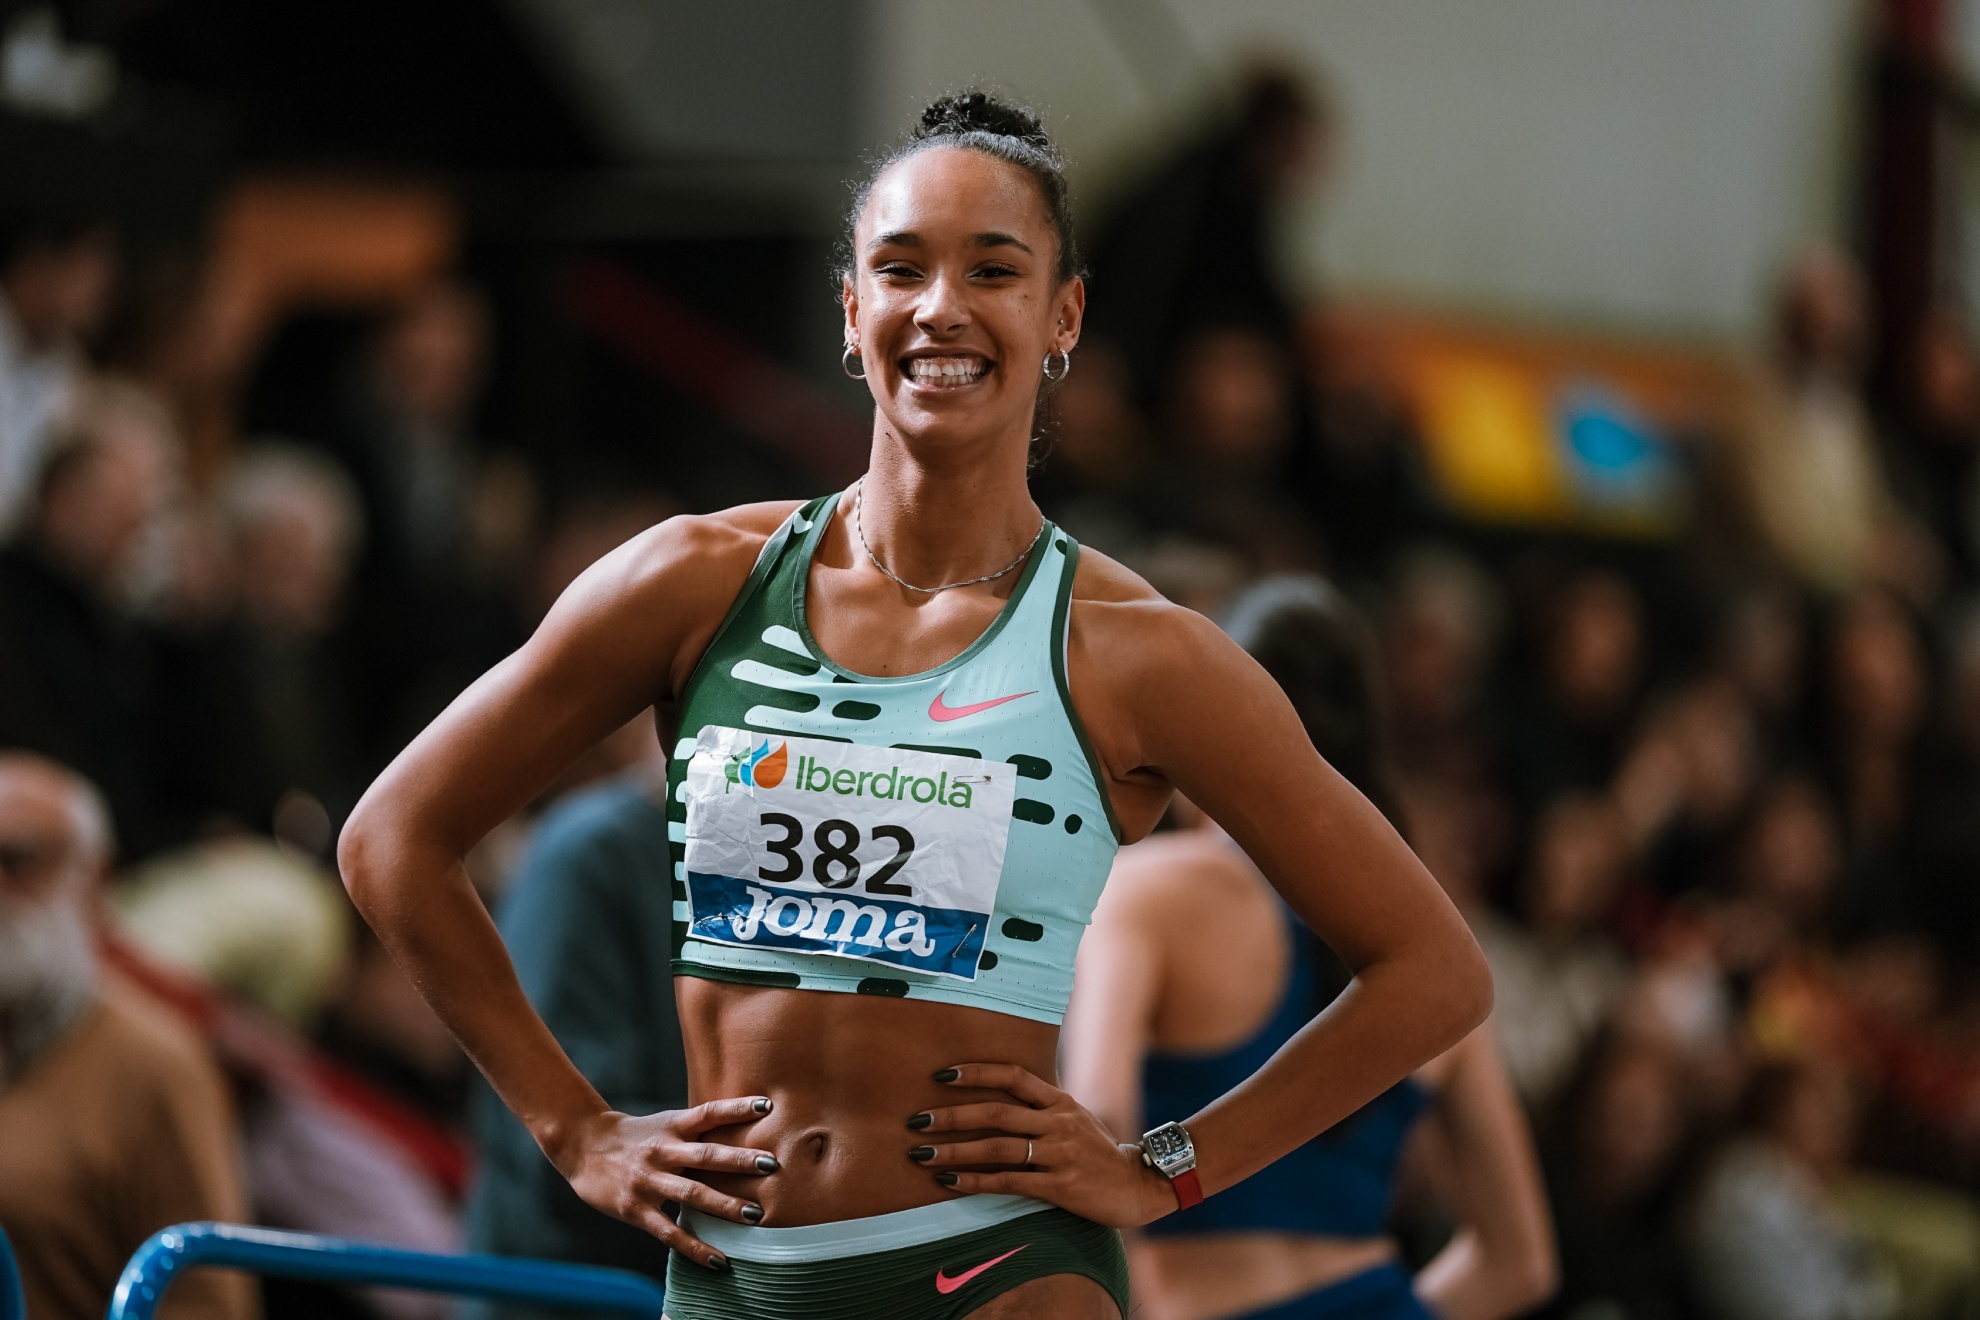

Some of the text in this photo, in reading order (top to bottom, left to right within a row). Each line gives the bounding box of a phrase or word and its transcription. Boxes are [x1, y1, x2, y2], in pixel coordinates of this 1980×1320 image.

[795, 756, 973, 808] Iberdrola
[758, 812, 916, 897] 382
[732, 885, 936, 957] Joma
